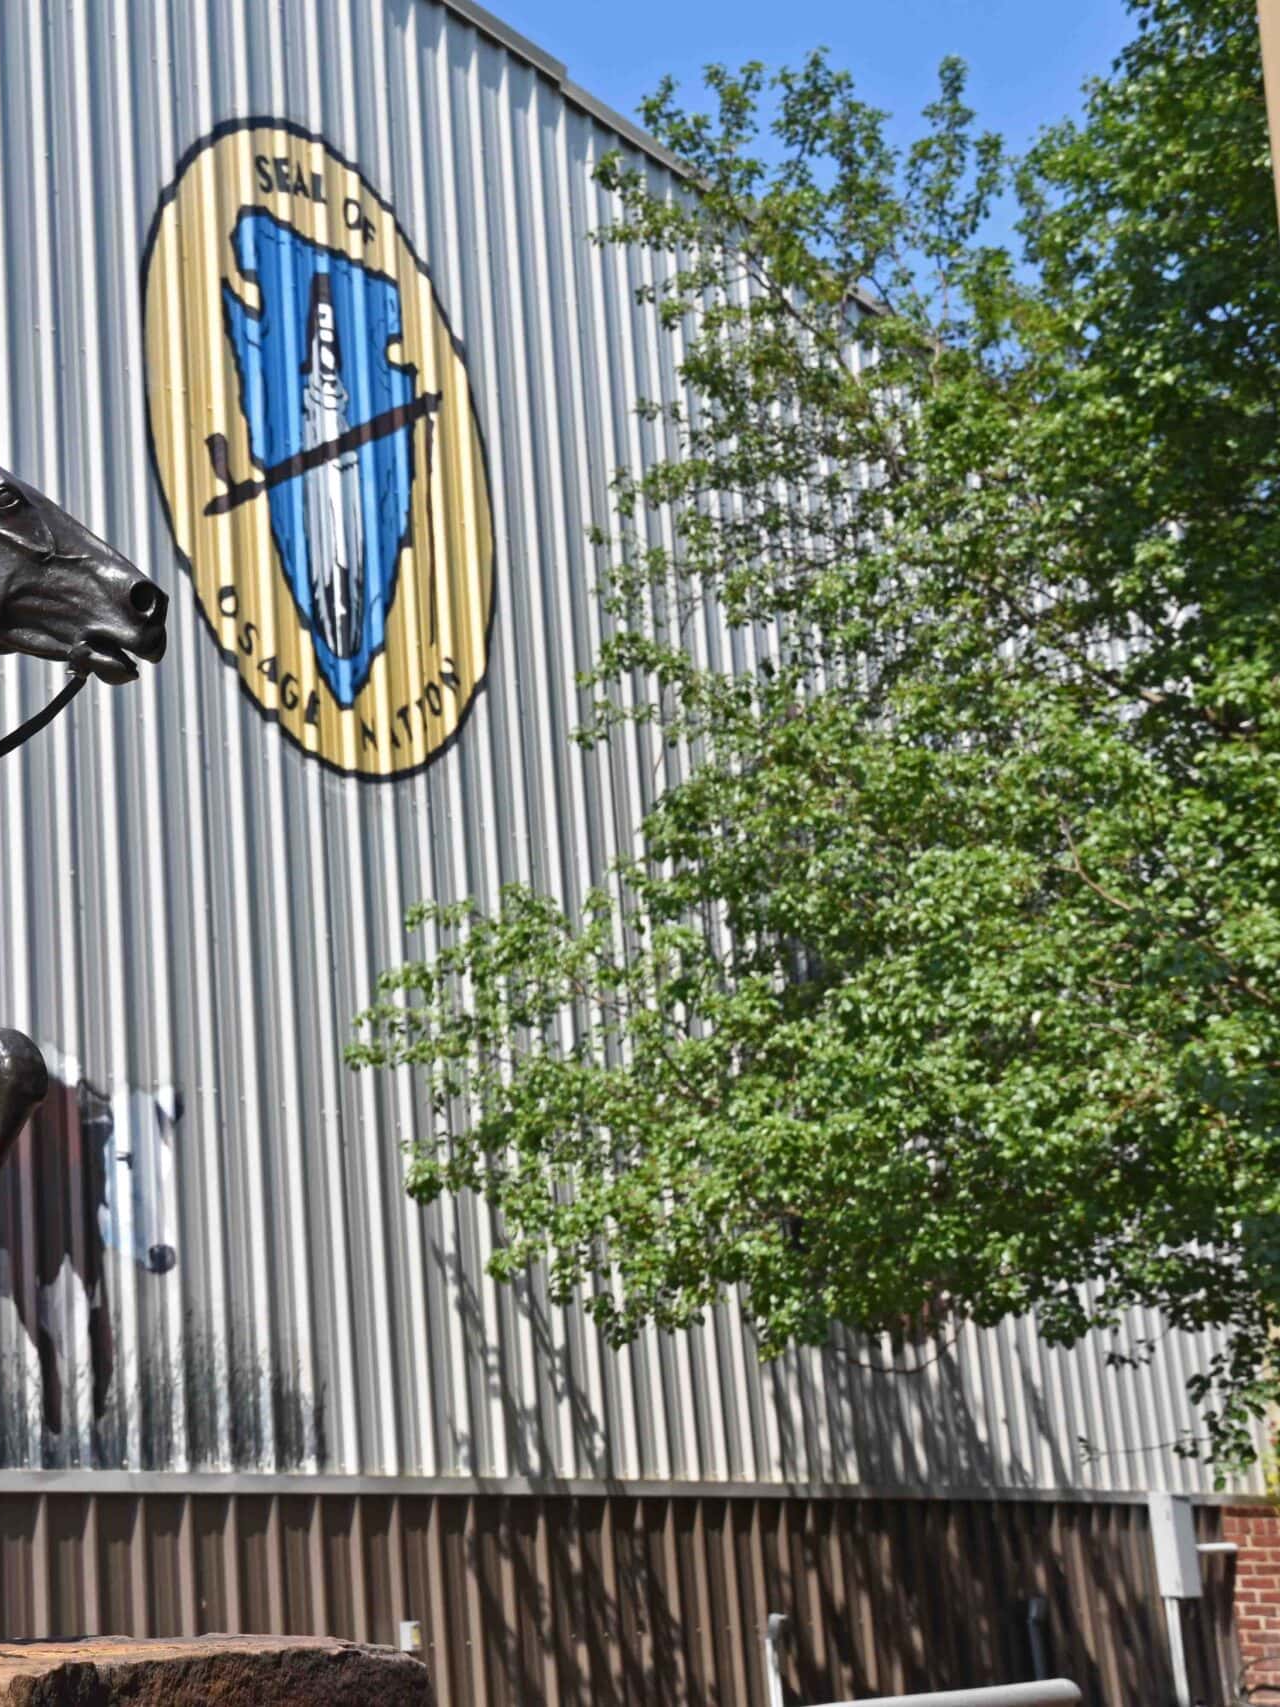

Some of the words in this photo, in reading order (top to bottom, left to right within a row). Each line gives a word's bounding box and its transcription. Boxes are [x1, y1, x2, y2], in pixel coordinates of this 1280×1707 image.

[255, 155, 328, 205] SEAL
[343, 197, 376, 244] OF
[218, 585, 321, 727] OSAGE
